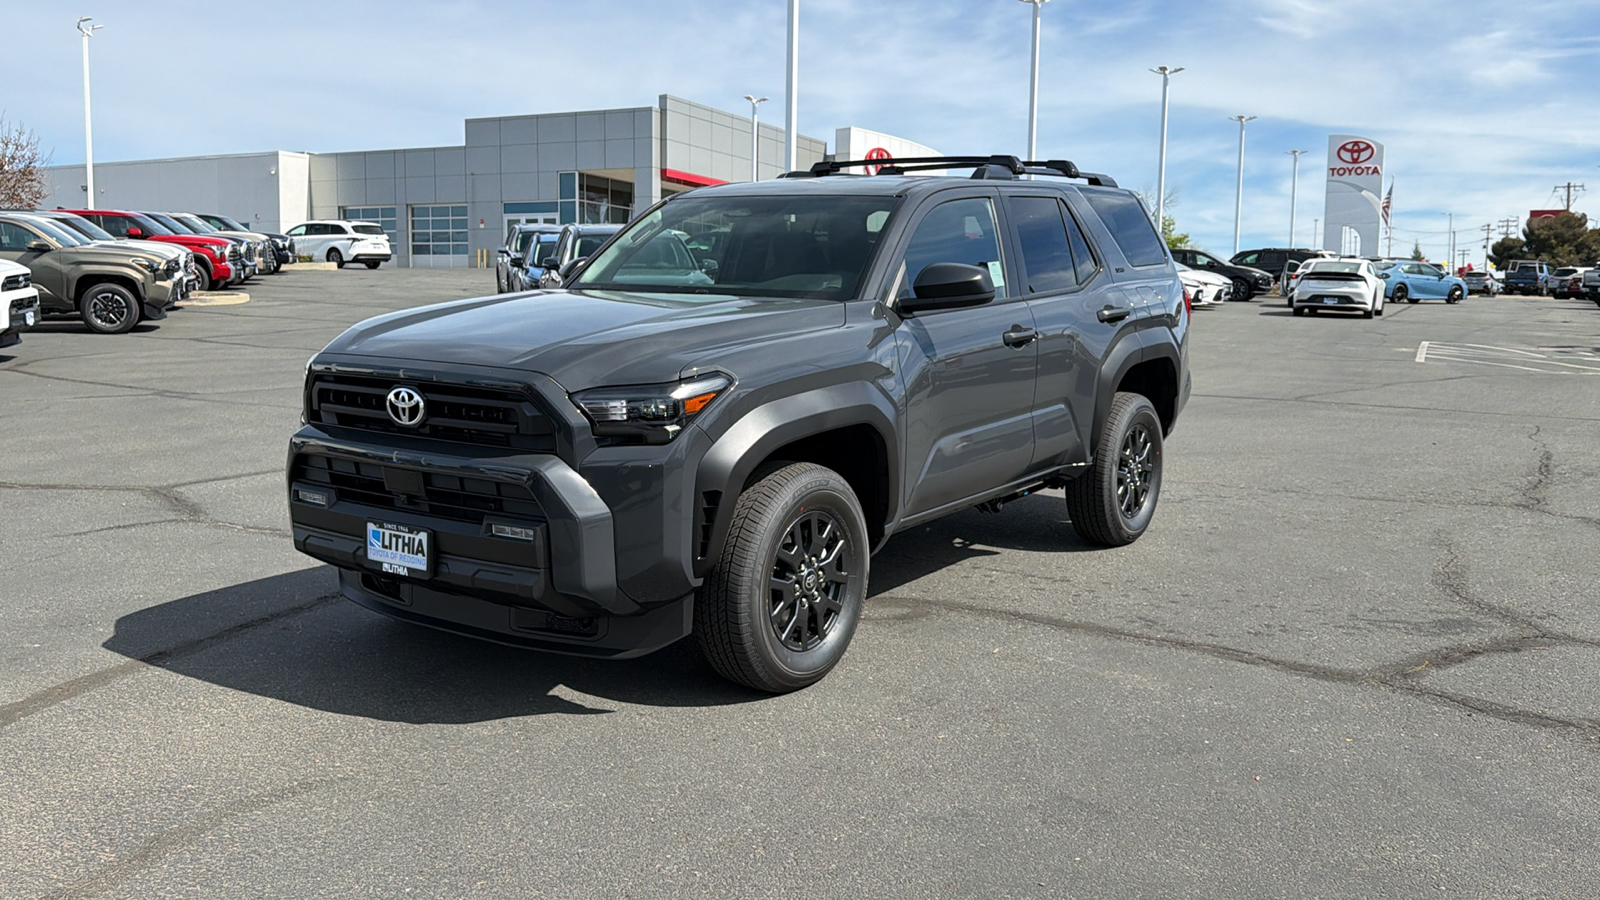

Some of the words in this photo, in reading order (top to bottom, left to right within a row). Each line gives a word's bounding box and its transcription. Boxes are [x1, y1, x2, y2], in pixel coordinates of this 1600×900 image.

[1329, 166, 1381, 177] TOYOTA
[381, 531, 426, 557] LITHIA
[369, 548, 390, 559] TOYOTA
[390, 551, 399, 560] OF
[399, 553, 426, 566] REDDING
[388, 564, 409, 576] LITHIA
